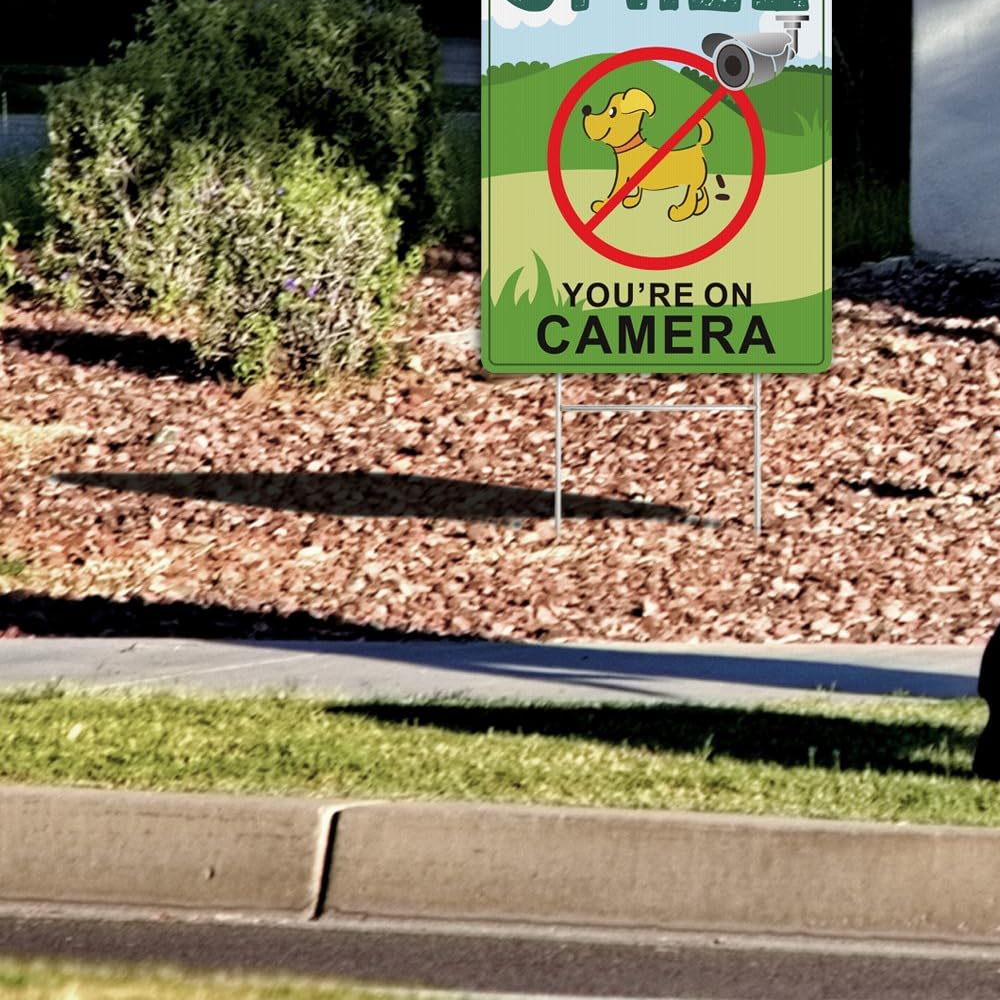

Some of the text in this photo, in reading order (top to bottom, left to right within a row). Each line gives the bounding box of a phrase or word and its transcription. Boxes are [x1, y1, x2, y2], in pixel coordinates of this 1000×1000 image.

[562, 282, 752, 308] YOU'RE ON
[537, 315, 776, 355] CAMERA
